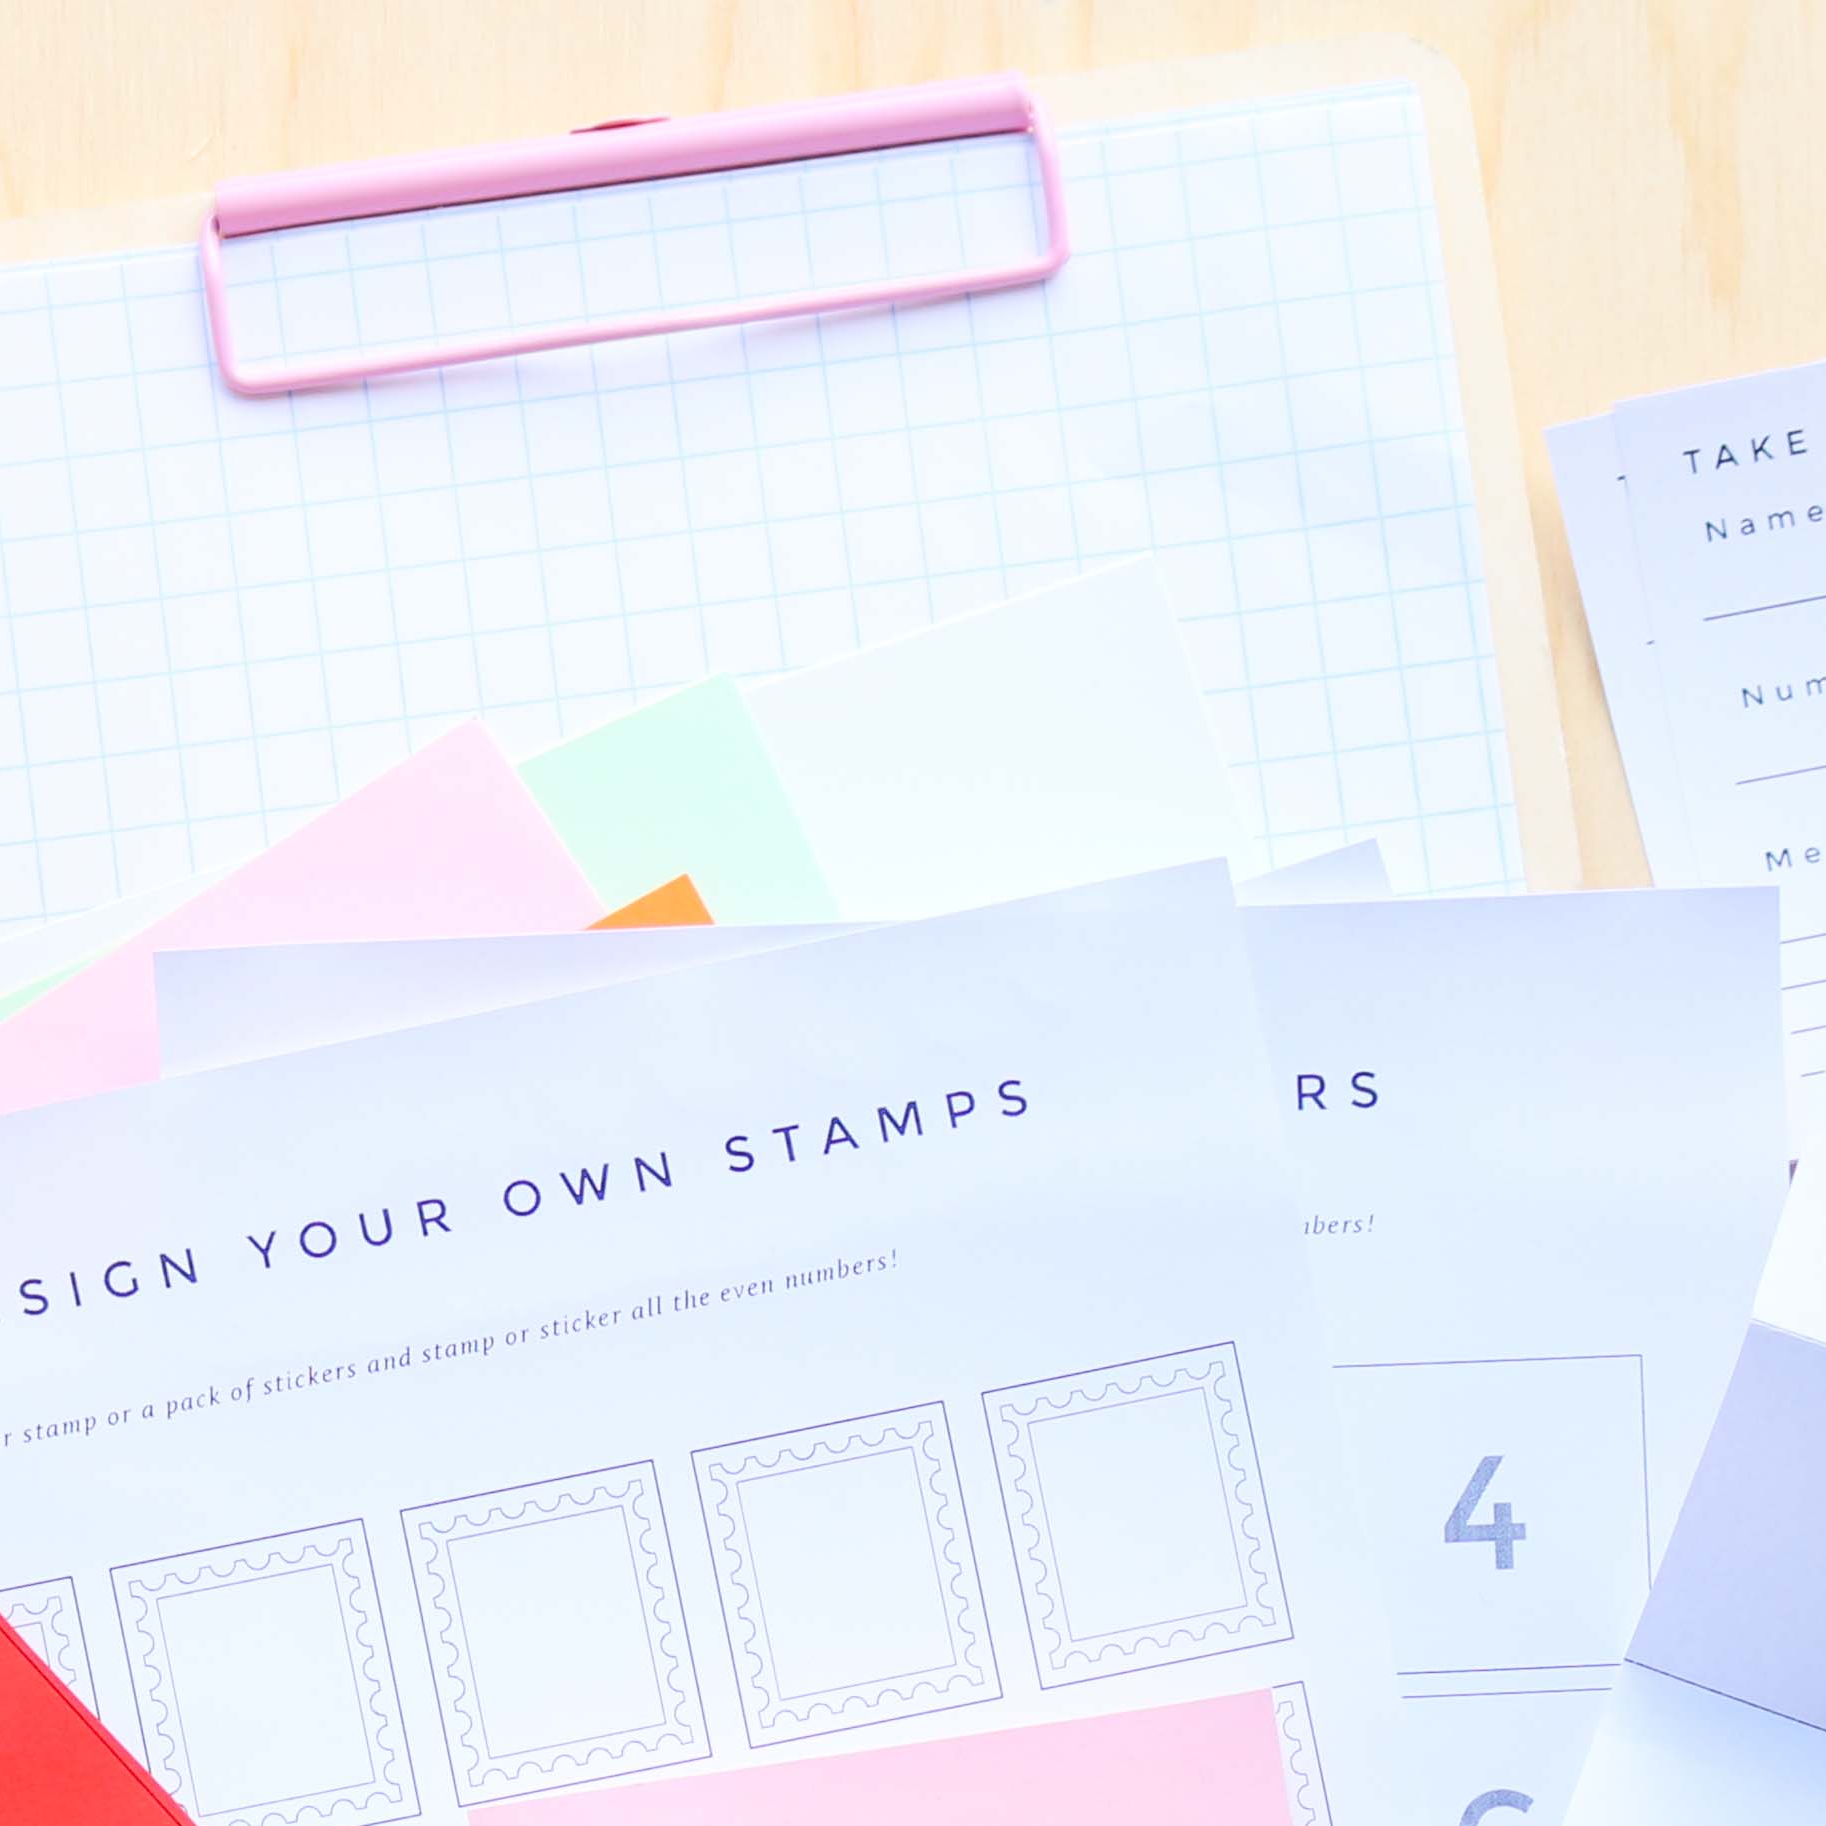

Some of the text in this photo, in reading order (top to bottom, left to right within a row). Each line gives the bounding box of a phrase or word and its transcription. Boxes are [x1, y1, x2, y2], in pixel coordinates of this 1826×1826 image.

[1682, 429, 1808, 474] TAKE
[1704, 505, 1824, 543] Name
[246, 1198, 452, 1269] YOUR
[503, 1151, 672, 1217] OWN
[725, 1079, 1028, 1173] STAMPS
[23, 1415, 97, 1444] stamp
[107, 1409, 131, 1426] or
[141, 1404, 154, 1419] a
[166, 1385, 221, 1420] pack
[230, 1377, 255, 1403] of
[263, 1363, 356, 1396] stickers
[367, 1345, 411, 1374] and
[422, 1336, 495, 1363] stamp
[505, 1328, 529, 1346] or
[540, 1309, 622, 1340] sticker
[631, 1295, 662, 1321] all
[673, 1289, 710, 1312] the
[720, 1279, 773, 1302] even
[785, 1249, 897, 1289] numbers!
[1443, 1455, 1527, 1571] 4
